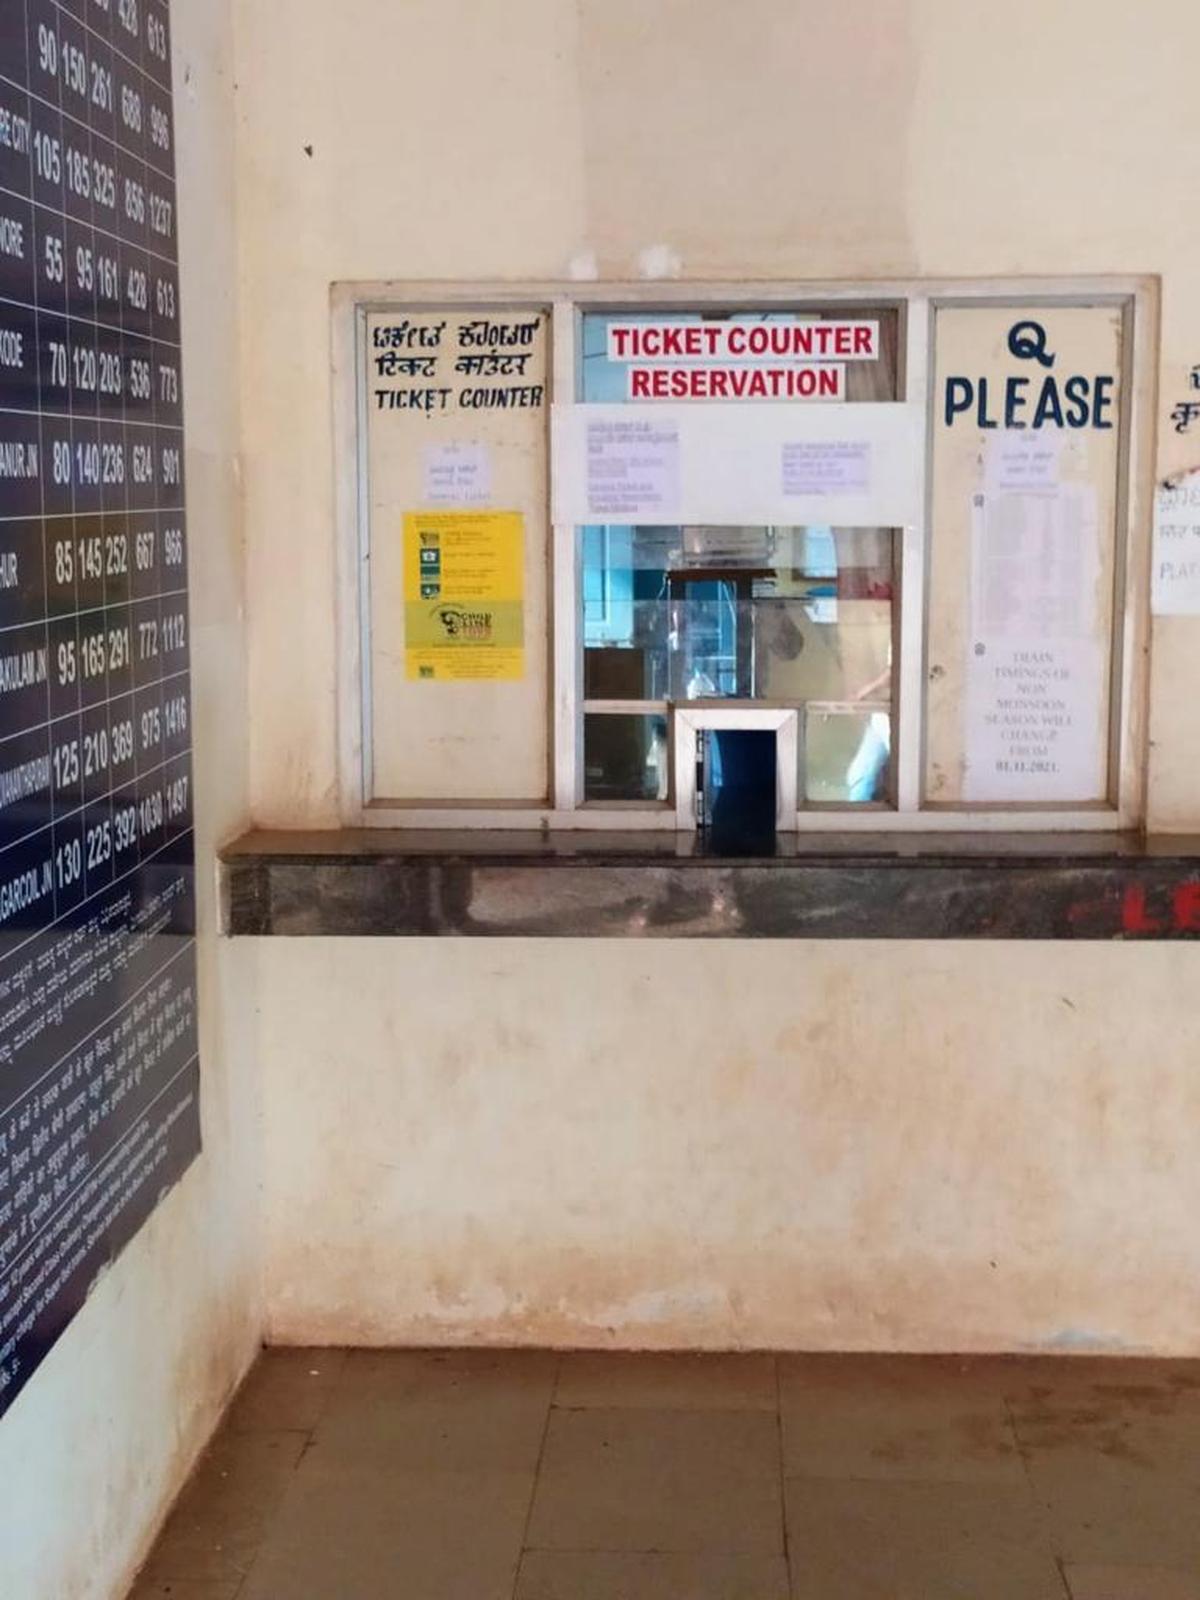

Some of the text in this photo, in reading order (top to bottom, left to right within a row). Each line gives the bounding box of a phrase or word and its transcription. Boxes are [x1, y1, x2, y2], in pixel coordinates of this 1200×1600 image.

[38, 24, 57, 76] 90
[62, 42, 86, 96] 150
[90, 61, 112, 113] 261
[34, 130, 61, 184] 105
[66, 147, 89, 198] 185
[93, 159, 115, 208] 325
[45, 236, 63, 283] 55
[76, 246, 93, 291] 95
[97, 257, 119, 300] 161
[127, 268, 147, 311] 428
[157, 278, 175, 320] 613
[612, 327, 872, 355] TICKET COUNTER
[1008, 321, 1056, 368] Q
[49, 342, 67, 388] 70
[73, 346, 96, 392] 120
[99, 352, 121, 395] 203
[159, 365, 178, 403] 773
[375, 385, 543, 412] TICKET COUNTER
[631, 369, 838, 396] RESERVATION
[945, 376, 1113, 429] PLEASE
[53, 442, 70, 484] 80
[77, 444, 99, 485] 140
[102, 444, 124, 484] 236
[133, 446, 153, 483] 624
[55, 540, 73, 584] 85
[78, 537, 102, 580] 145
[105, 534, 127, 575] 252
[136, 532, 154, 571] 667
[58, 641, 76, 686] 95
[82, 633, 105, 679] 165
[108, 626, 130, 669] 291
[139, 620, 158, 660] 772
[162, 614, 185, 652] 1112
[53, 740, 79, 789] 125
[84, 729, 108, 777] 210
[111, 720, 133, 765] 369
[141, 707, 160, 749] 975
[164, 695, 187, 737] 1416
[56, 838, 81, 888] 130
[87, 820, 111, 870] 225
[114, 805, 136, 851] 392
[139, 790, 162, 836] 1030
